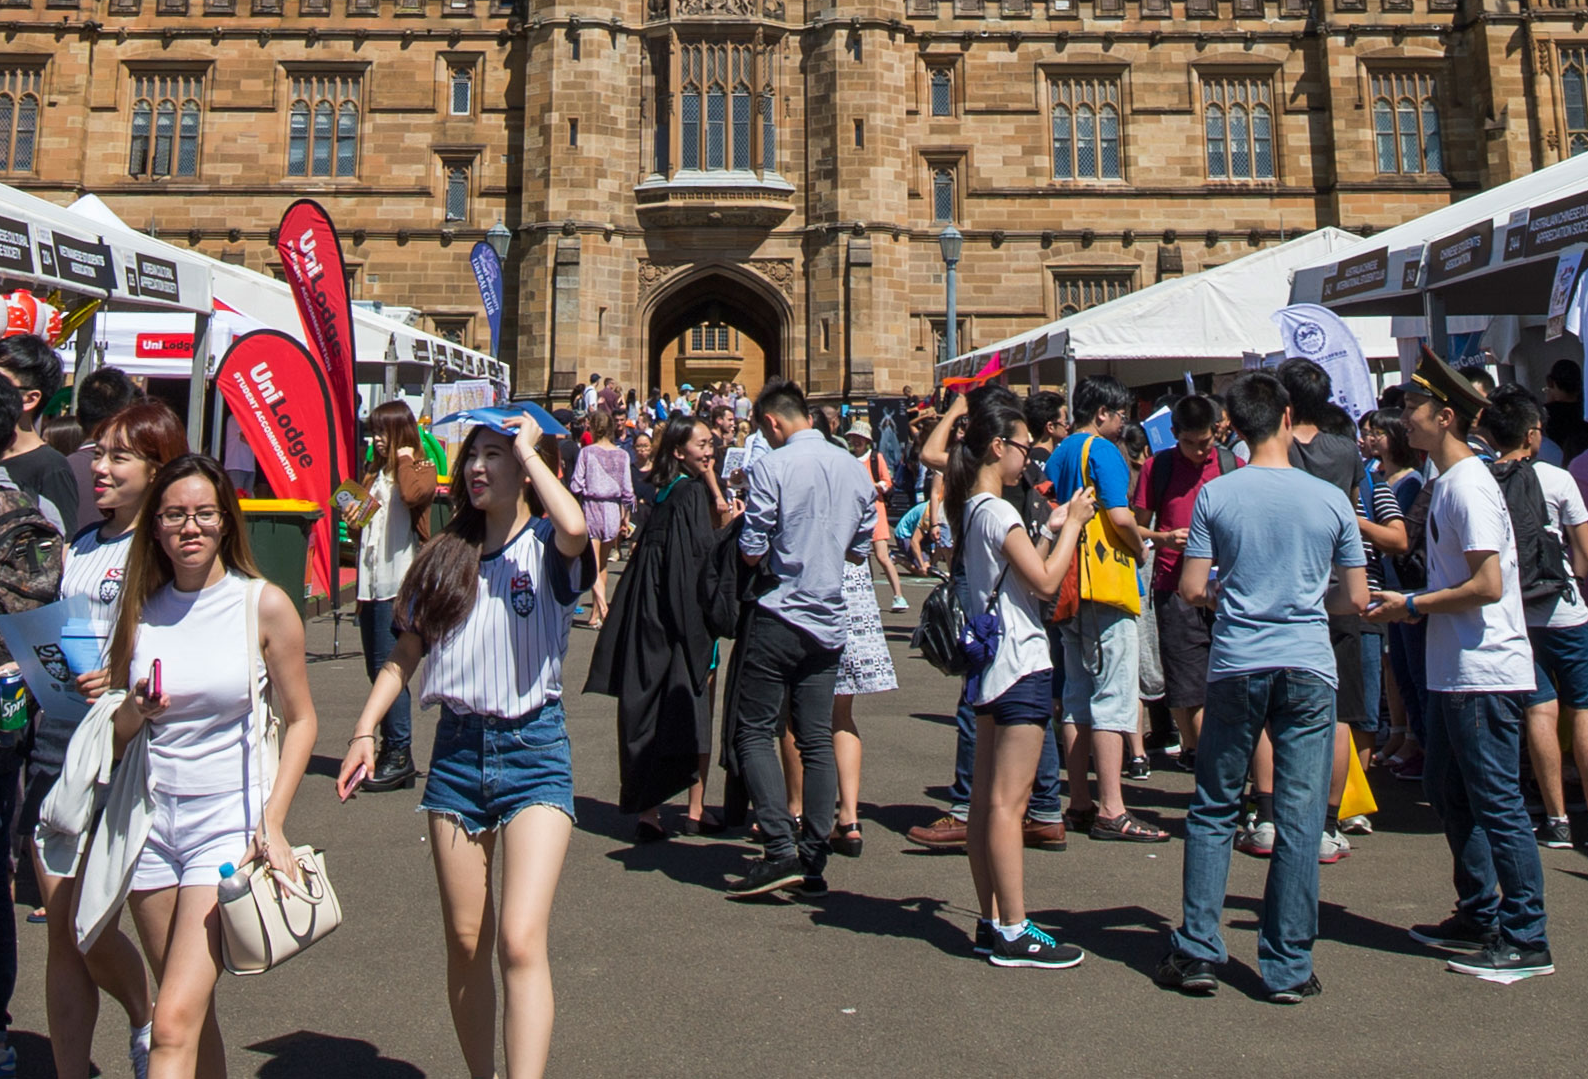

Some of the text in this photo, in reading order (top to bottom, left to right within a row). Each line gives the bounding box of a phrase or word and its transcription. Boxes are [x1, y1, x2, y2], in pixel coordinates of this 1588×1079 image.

[299, 229, 342, 357] UniLodge
[300, 284, 332, 372] ACCOMMODATION
[483, 291, 496, 316] CLUB
[233, 372, 298, 482] STUDENT ACCOMMODATION
[250, 361, 313, 469] UniLodge
